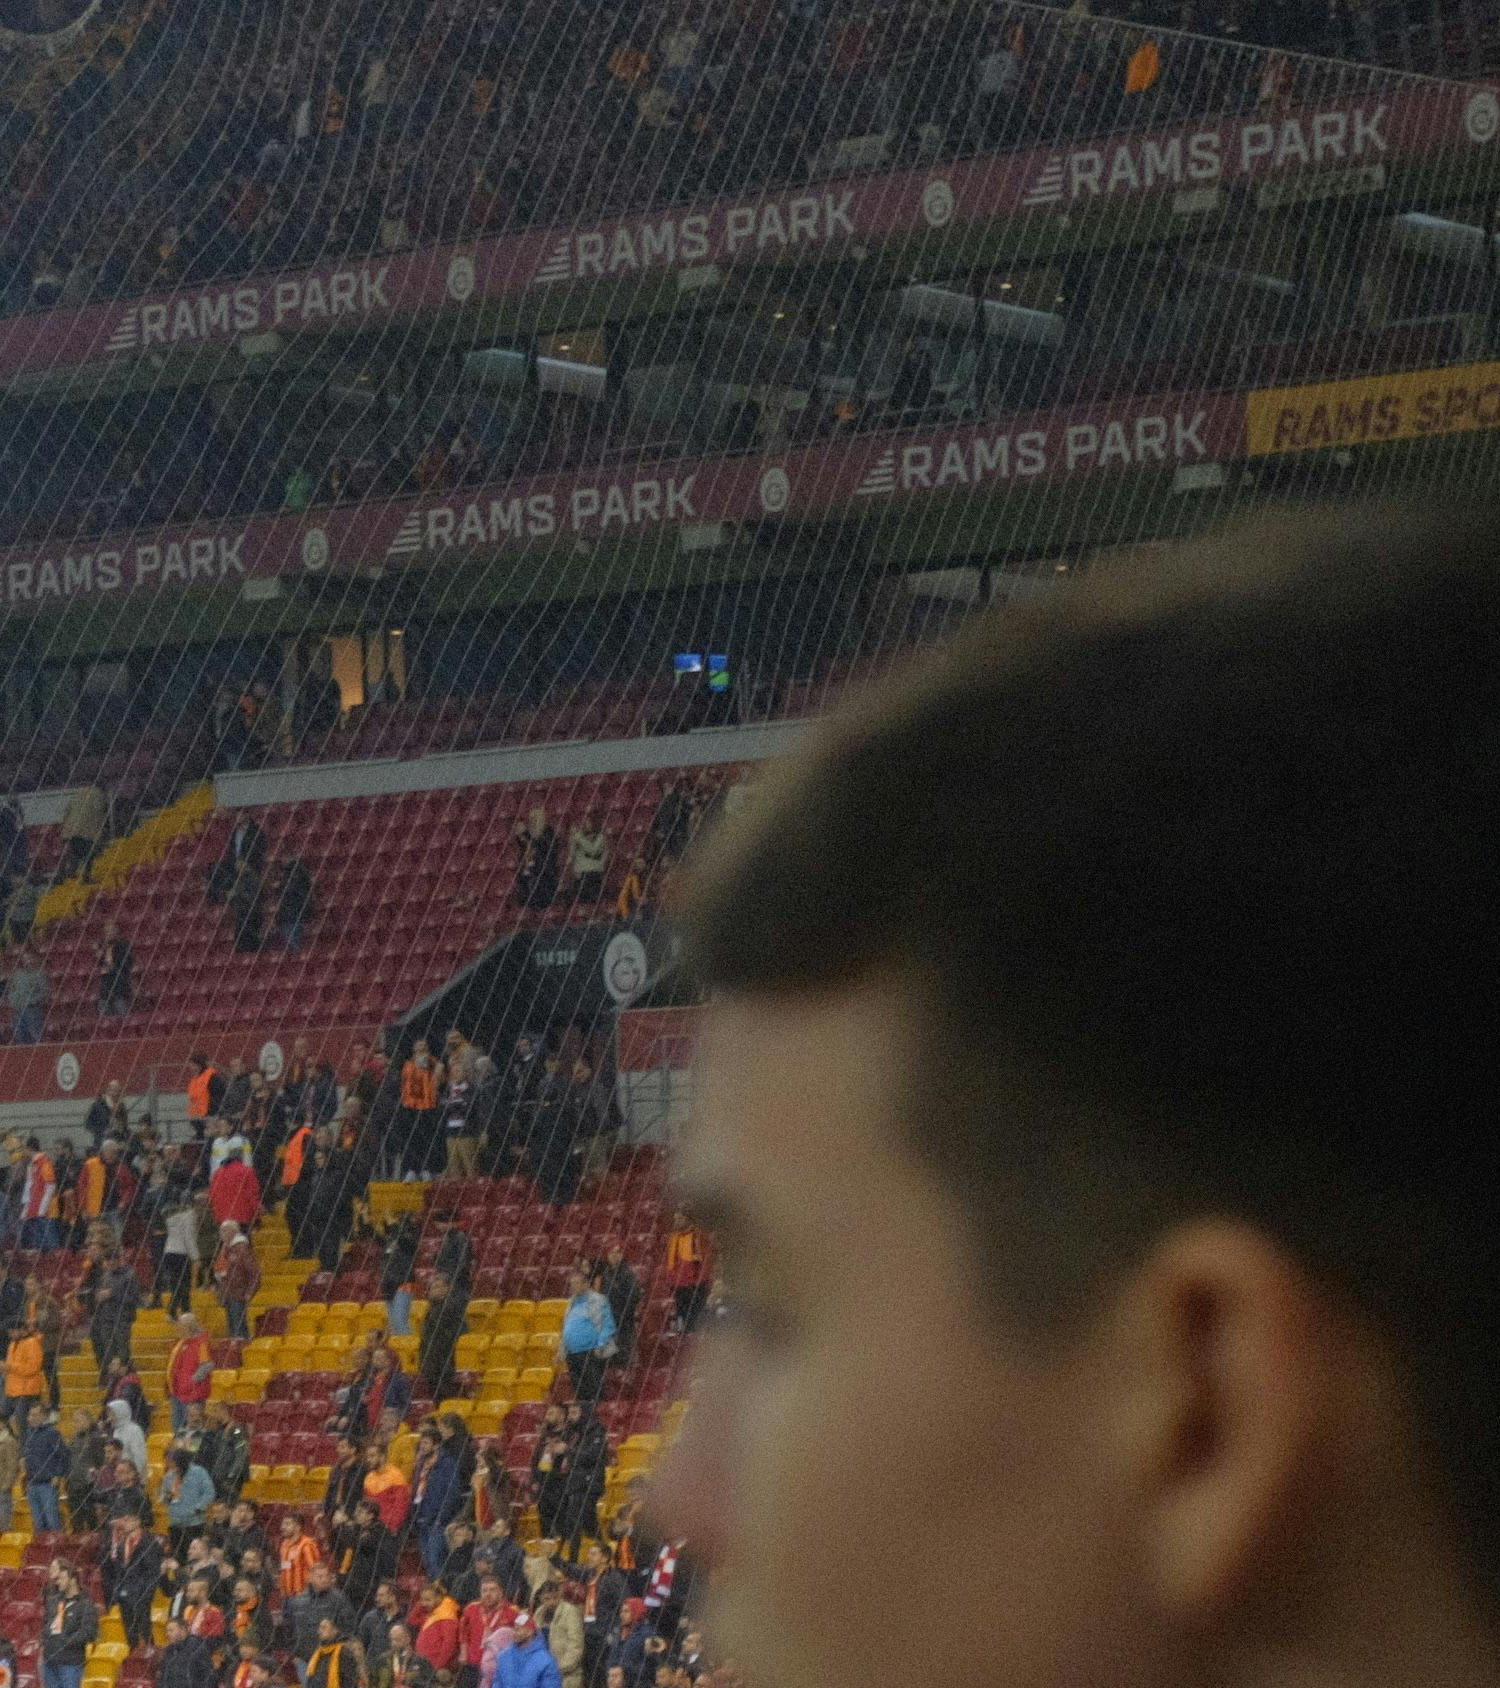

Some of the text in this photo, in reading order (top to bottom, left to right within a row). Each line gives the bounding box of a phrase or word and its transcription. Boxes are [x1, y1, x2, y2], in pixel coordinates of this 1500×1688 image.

[1069, 104, 1391, 199] RAMS PARK
[574, 189, 857, 278] RAMS PARK
[141, 266, 389, 345] RAMS PARK
[901, 410, 1205, 490] RAMS PARK
[1275, 401, 1399, 450] RAMS
[426, 475, 694, 547] RAMS PARK
[7, 533, 246, 602] RAMS PARK
